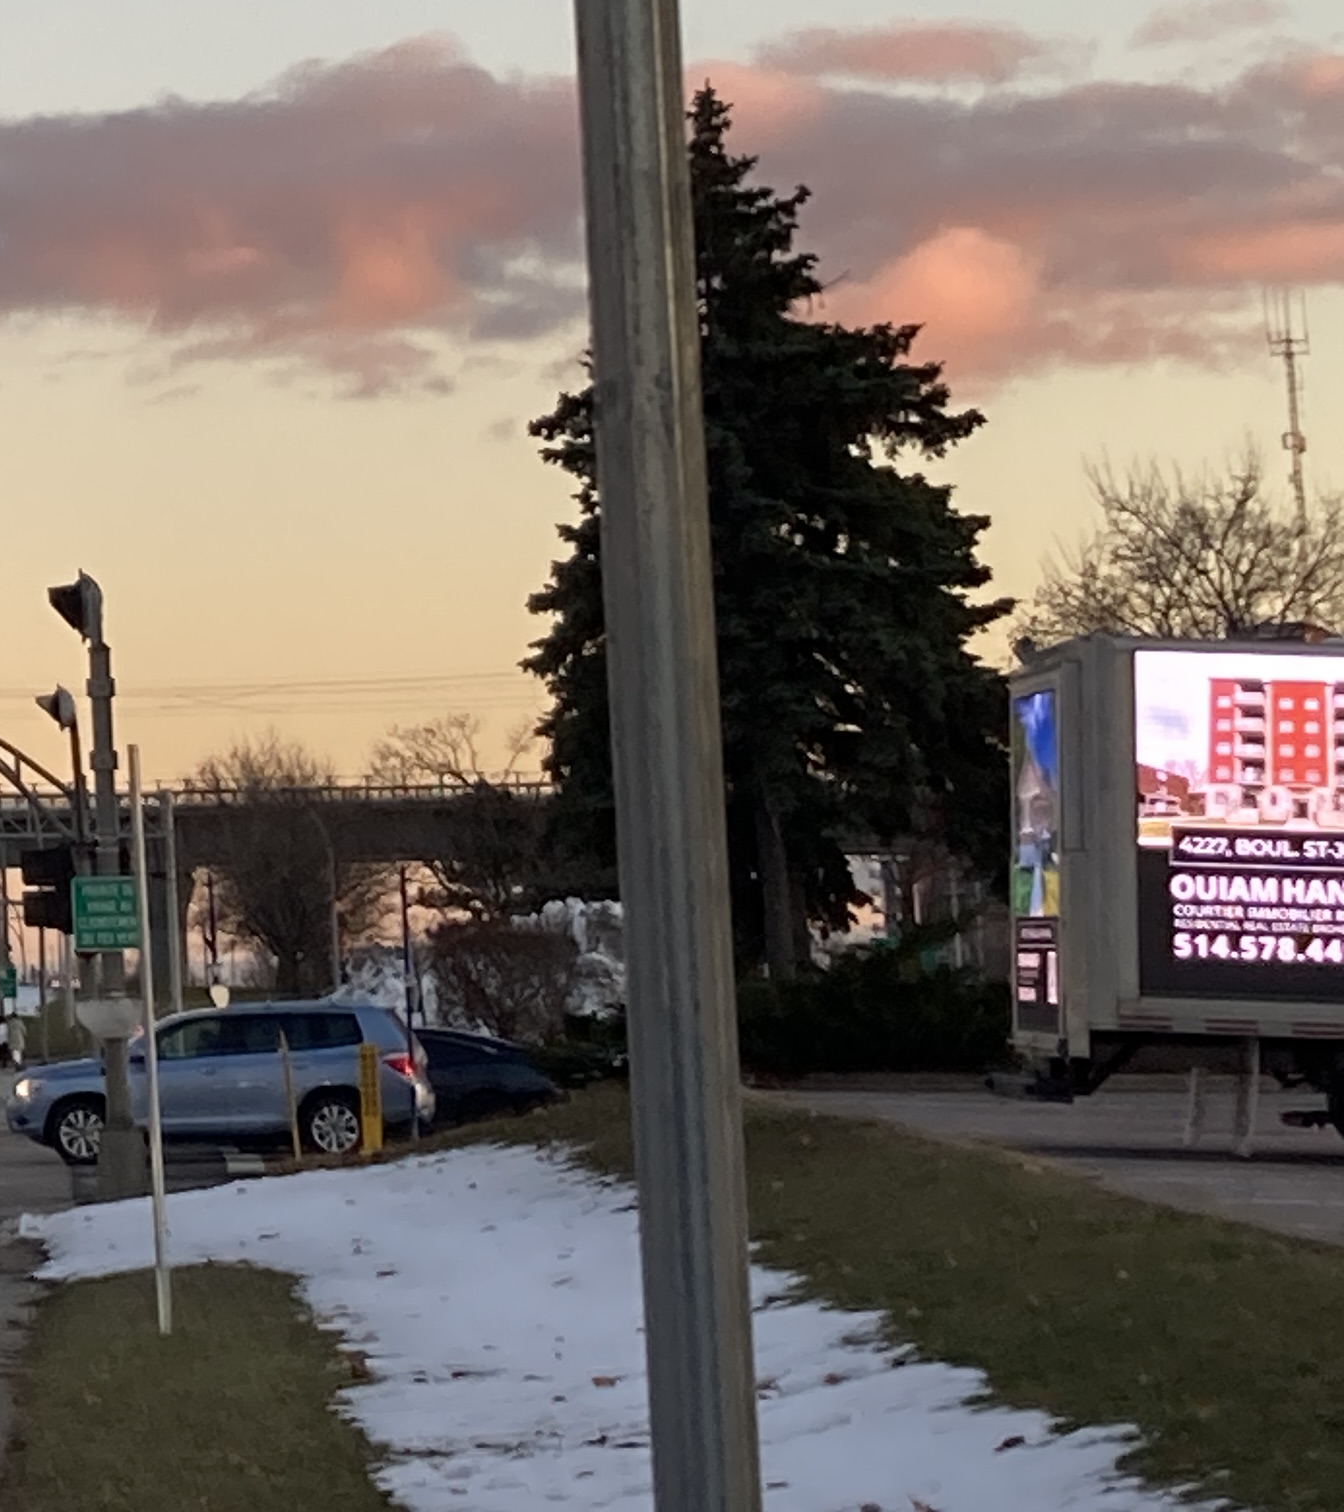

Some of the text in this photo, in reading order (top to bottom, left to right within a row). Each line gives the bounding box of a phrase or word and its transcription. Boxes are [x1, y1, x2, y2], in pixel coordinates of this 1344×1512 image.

[1235, 838, 1300, 857] BOUL.
[1170, 874, 1278, 904] OUIAM
[1173, 932, 1344, 963] 514.578.44
